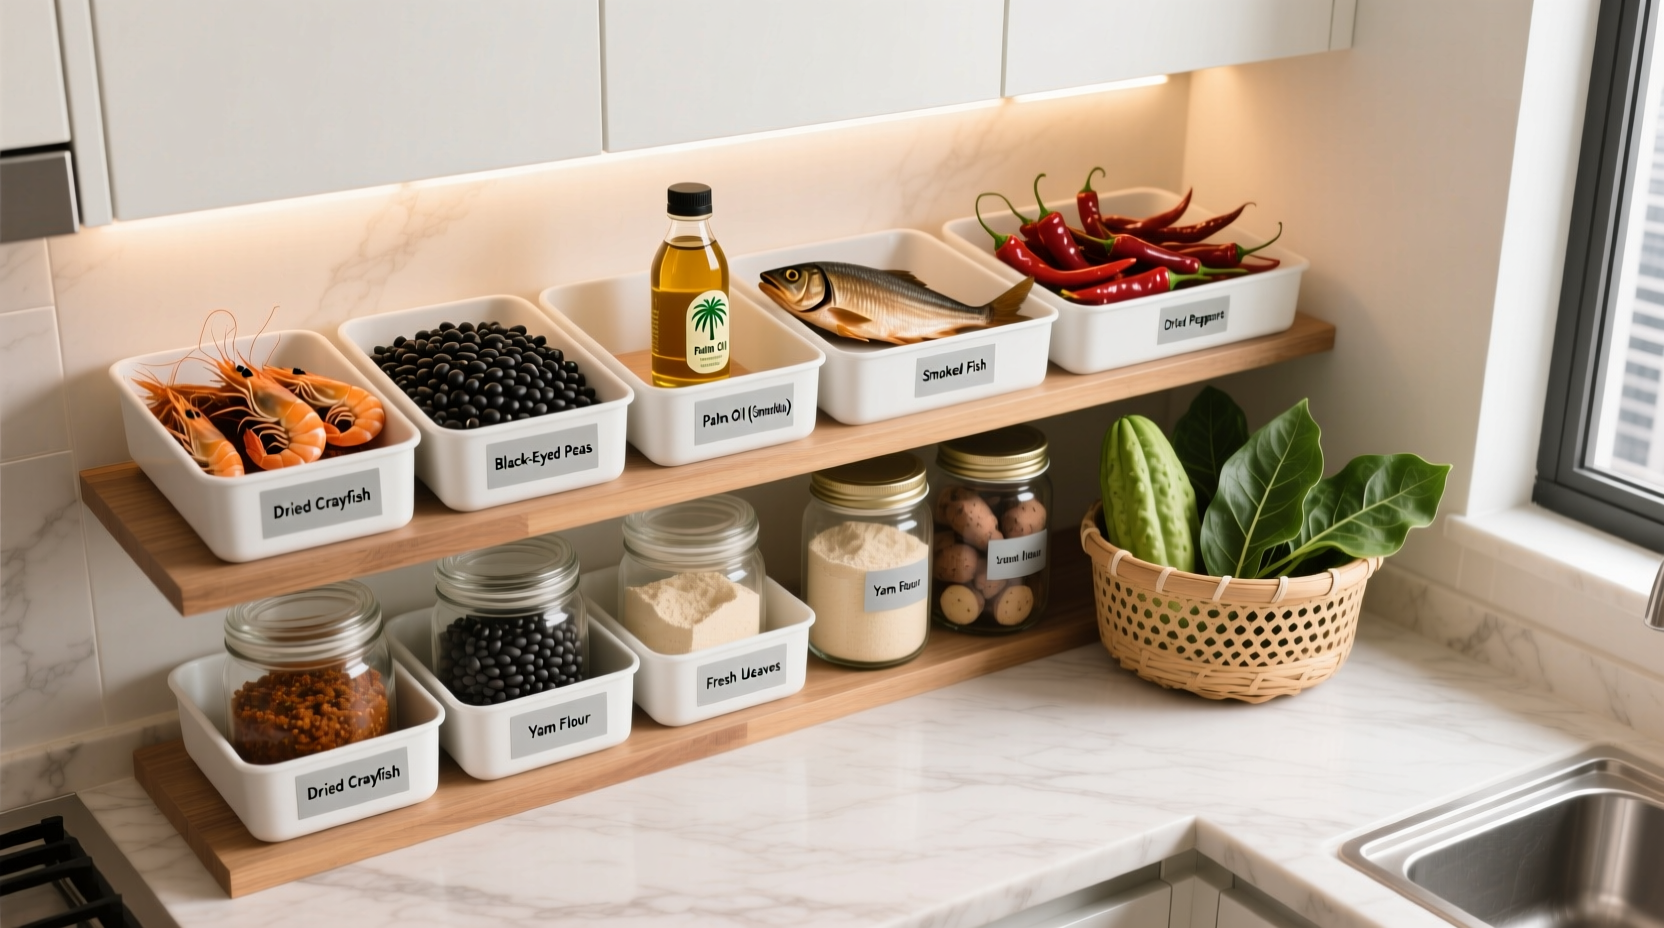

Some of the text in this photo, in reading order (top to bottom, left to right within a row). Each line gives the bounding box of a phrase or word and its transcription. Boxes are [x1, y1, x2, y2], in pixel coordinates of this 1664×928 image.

[966, 358, 986, 374] Fish
[495, 443, 593, 471] Black-Eyed Peas
[273, 487, 371, 519] Dried Crayfish
[873, 584, 897, 597] Yam
[706, 670, 737, 690] Fresh
[528, 713, 591, 739] Yam Flour
[307, 764, 401, 801] Dried Crayfish
